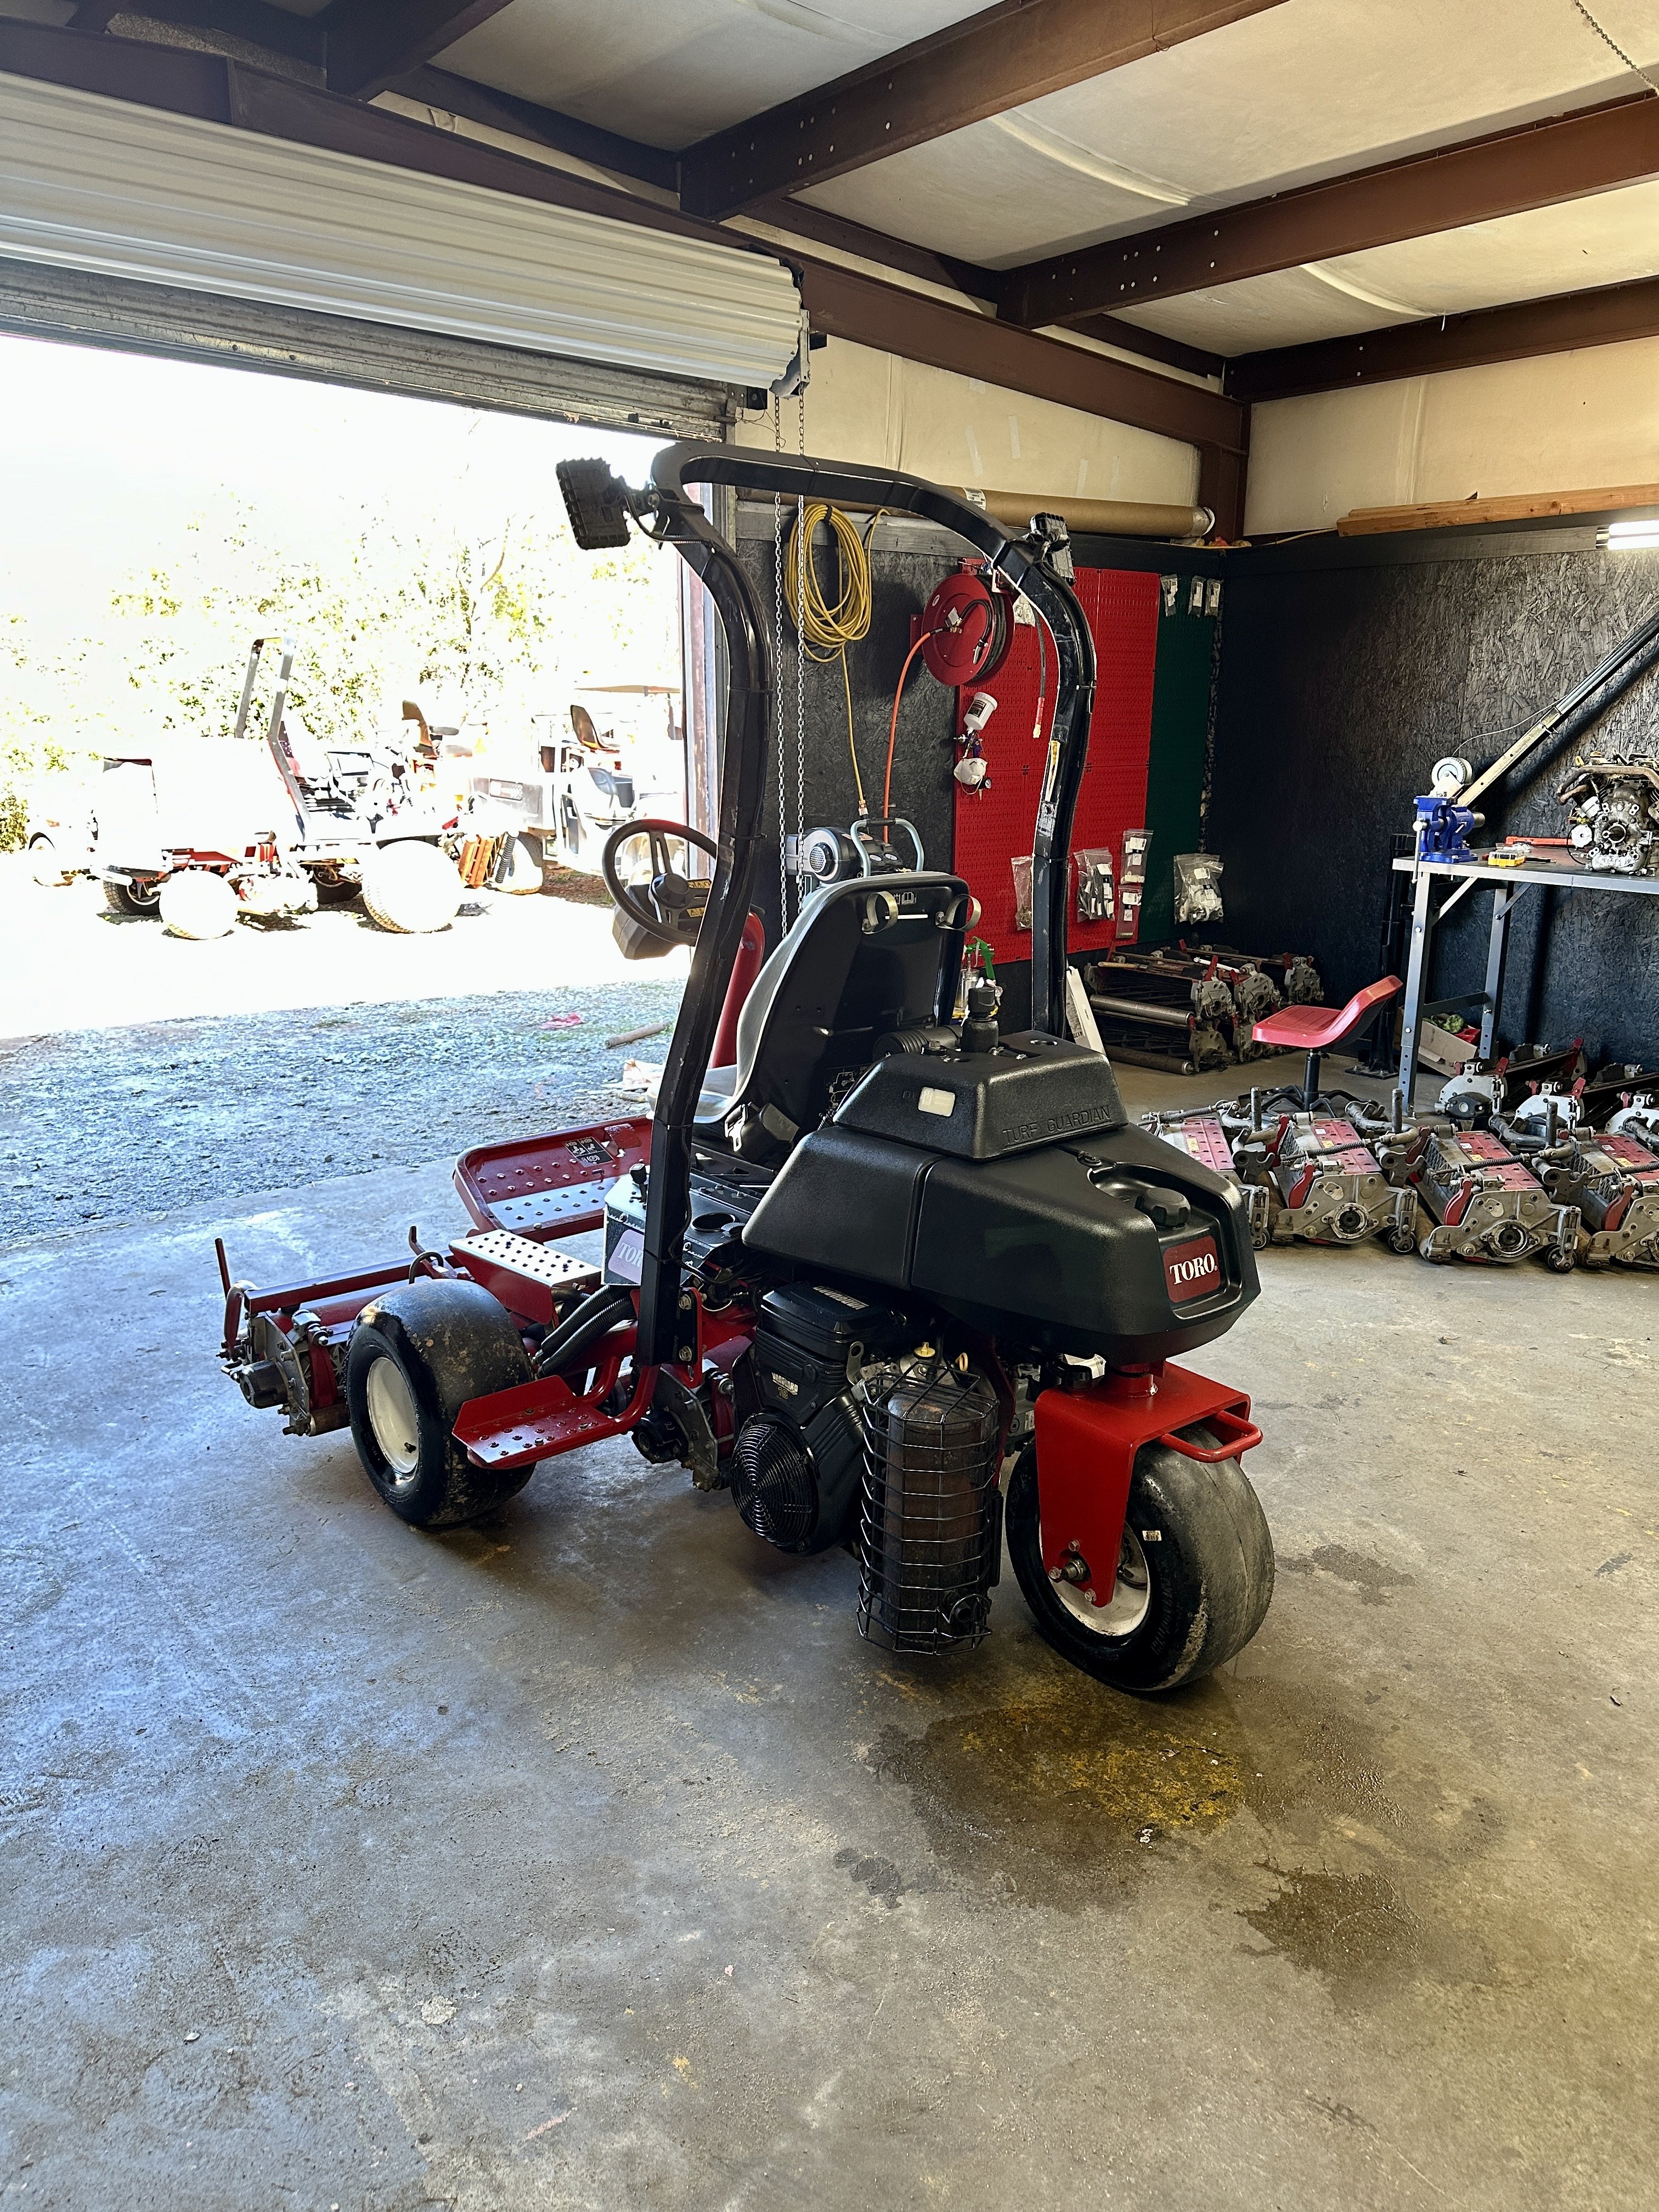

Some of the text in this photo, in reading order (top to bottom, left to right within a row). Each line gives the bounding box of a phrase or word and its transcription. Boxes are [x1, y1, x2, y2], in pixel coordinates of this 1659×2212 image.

[1002, 1105, 1111, 1144] TURF GUARDIAN
[618, 1242, 643, 1267] TOR
[1169, 1253, 1215, 1285] TORO
